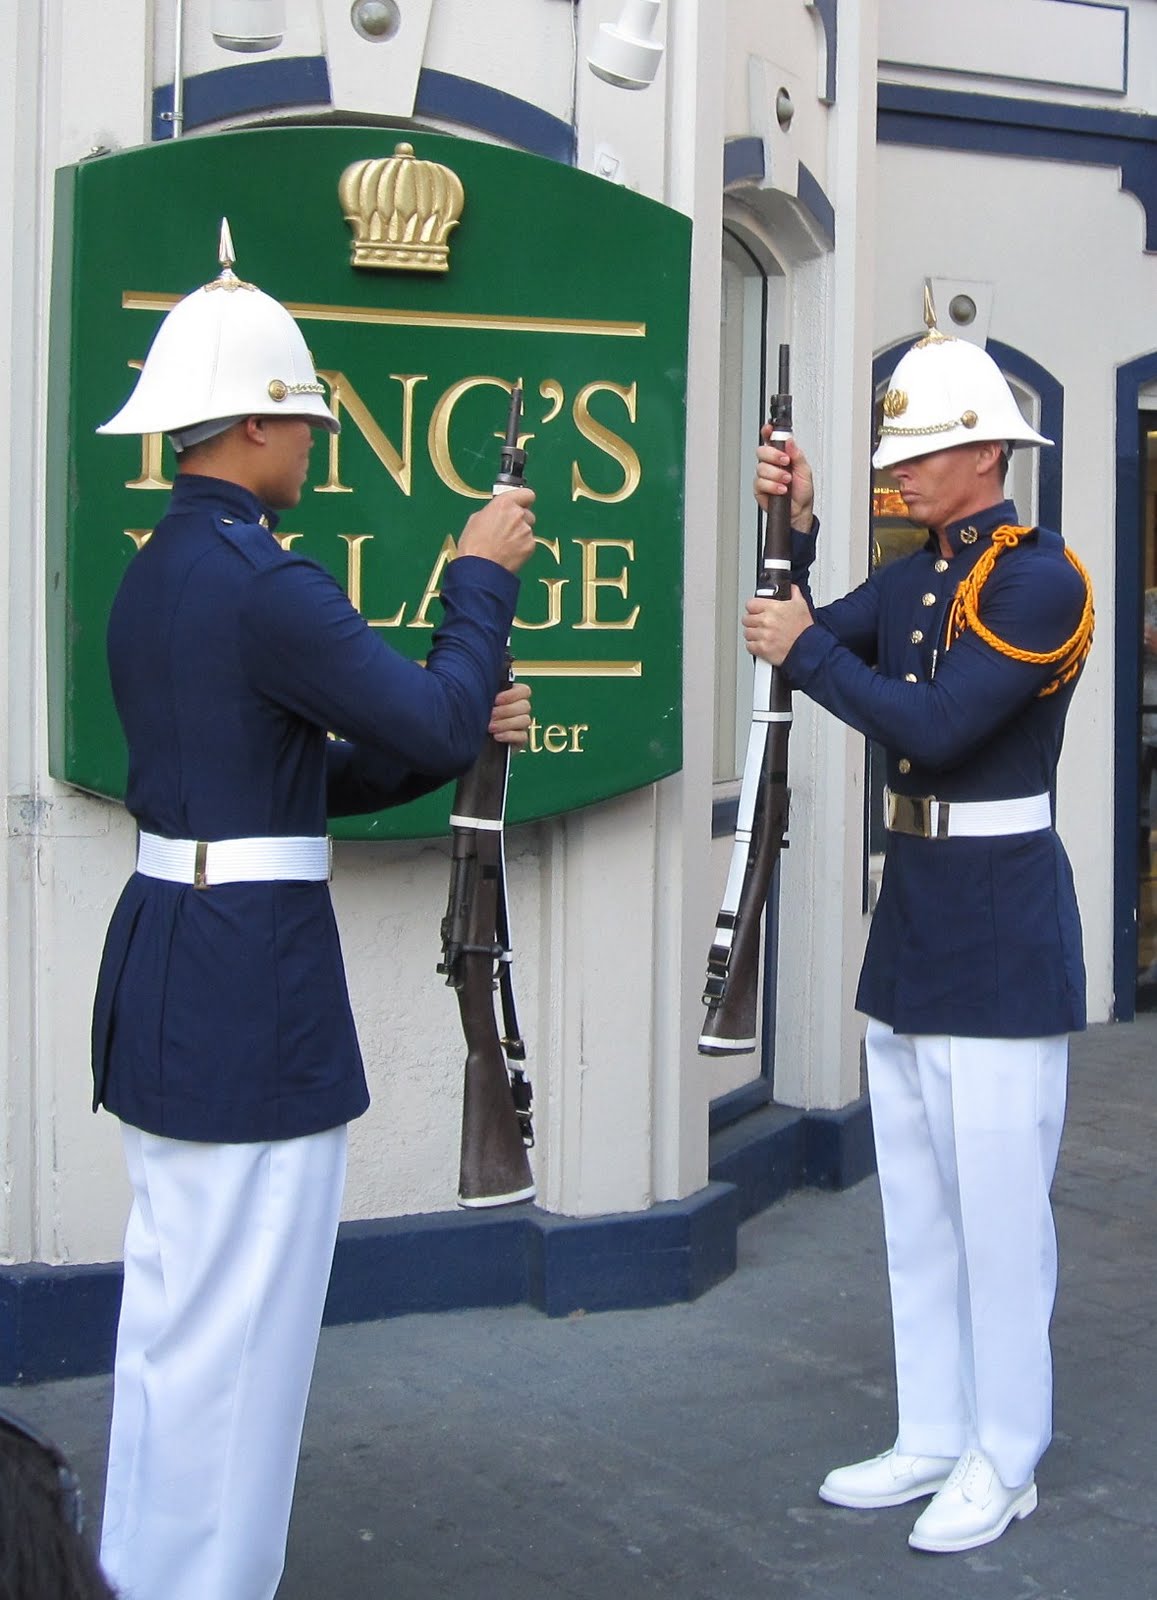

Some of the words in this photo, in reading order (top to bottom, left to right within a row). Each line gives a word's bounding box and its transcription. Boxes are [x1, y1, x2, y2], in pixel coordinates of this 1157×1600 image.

[125, 359, 641, 504] NG'S
[124, 529, 640, 630] LAGE
[519, 716, 589, 753] ter
